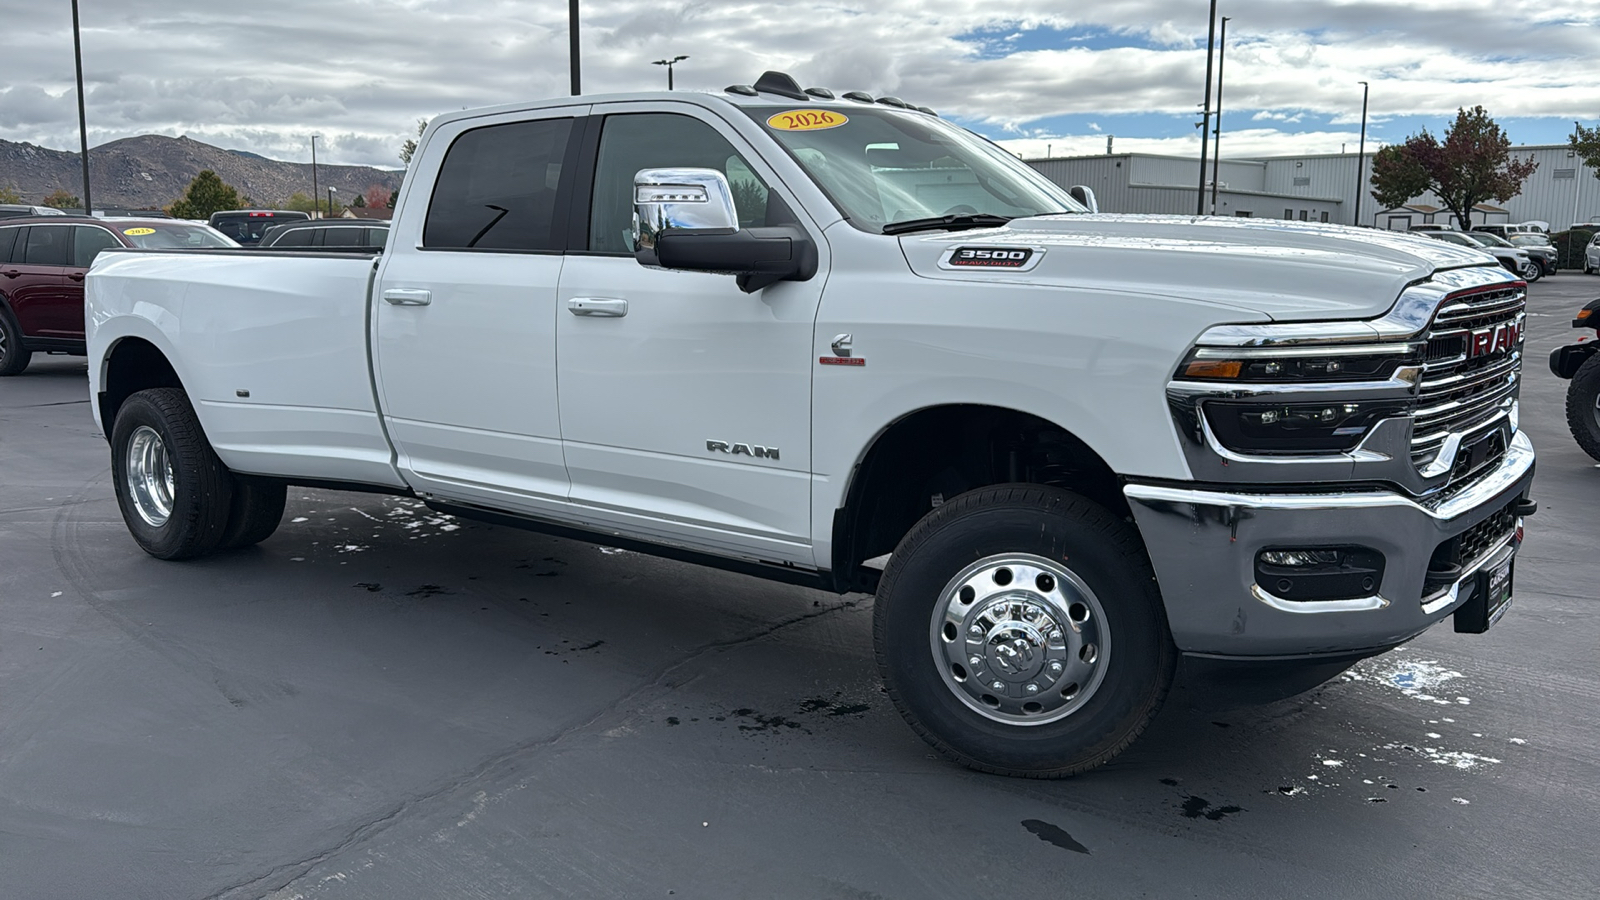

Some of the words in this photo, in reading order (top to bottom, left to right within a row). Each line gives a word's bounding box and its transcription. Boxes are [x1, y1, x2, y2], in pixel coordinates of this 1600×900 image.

[782, 111, 834, 129] 2026
[960, 250, 1025, 259] 3500
[706, 439, 780, 460] RAM
